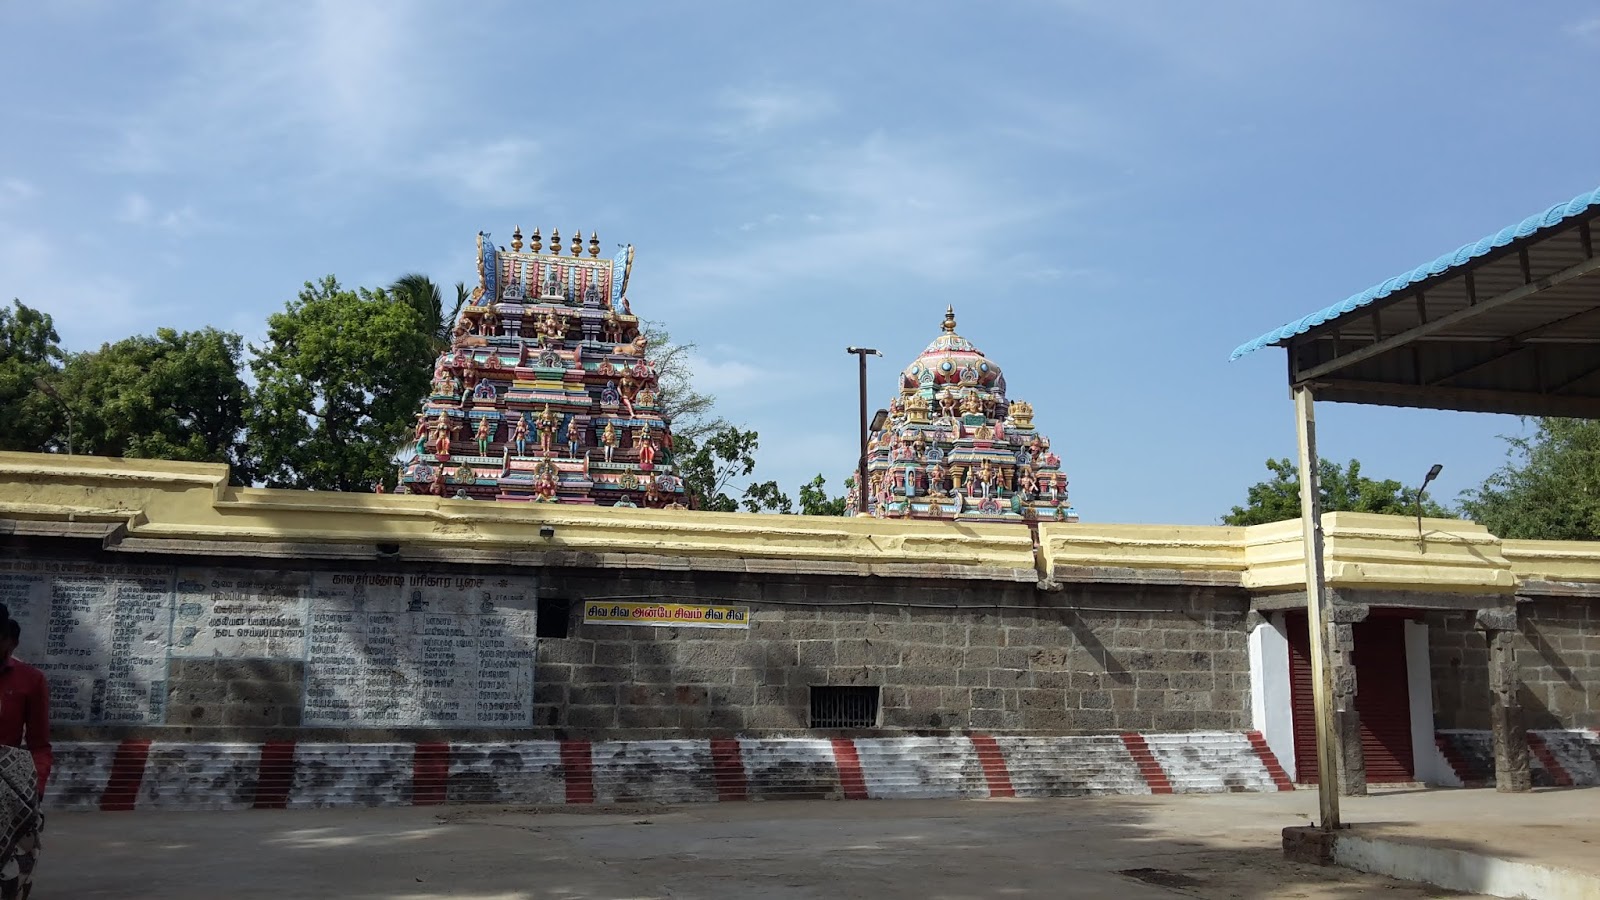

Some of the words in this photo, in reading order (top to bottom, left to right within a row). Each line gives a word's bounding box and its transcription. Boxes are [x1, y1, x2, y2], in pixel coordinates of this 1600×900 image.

[409, 573, 453, 589] பரிகார
[455, 577, 485, 592] பூசை
[587, 605, 608, 618] சிவ
[610, 605, 630, 618] சிவ
[632, 606, 672, 619] அன்பே
[674, 607, 702, 620] சிவம்
[704, 608, 723, 620] சிவ
[726, 608, 745, 621] சிவ
